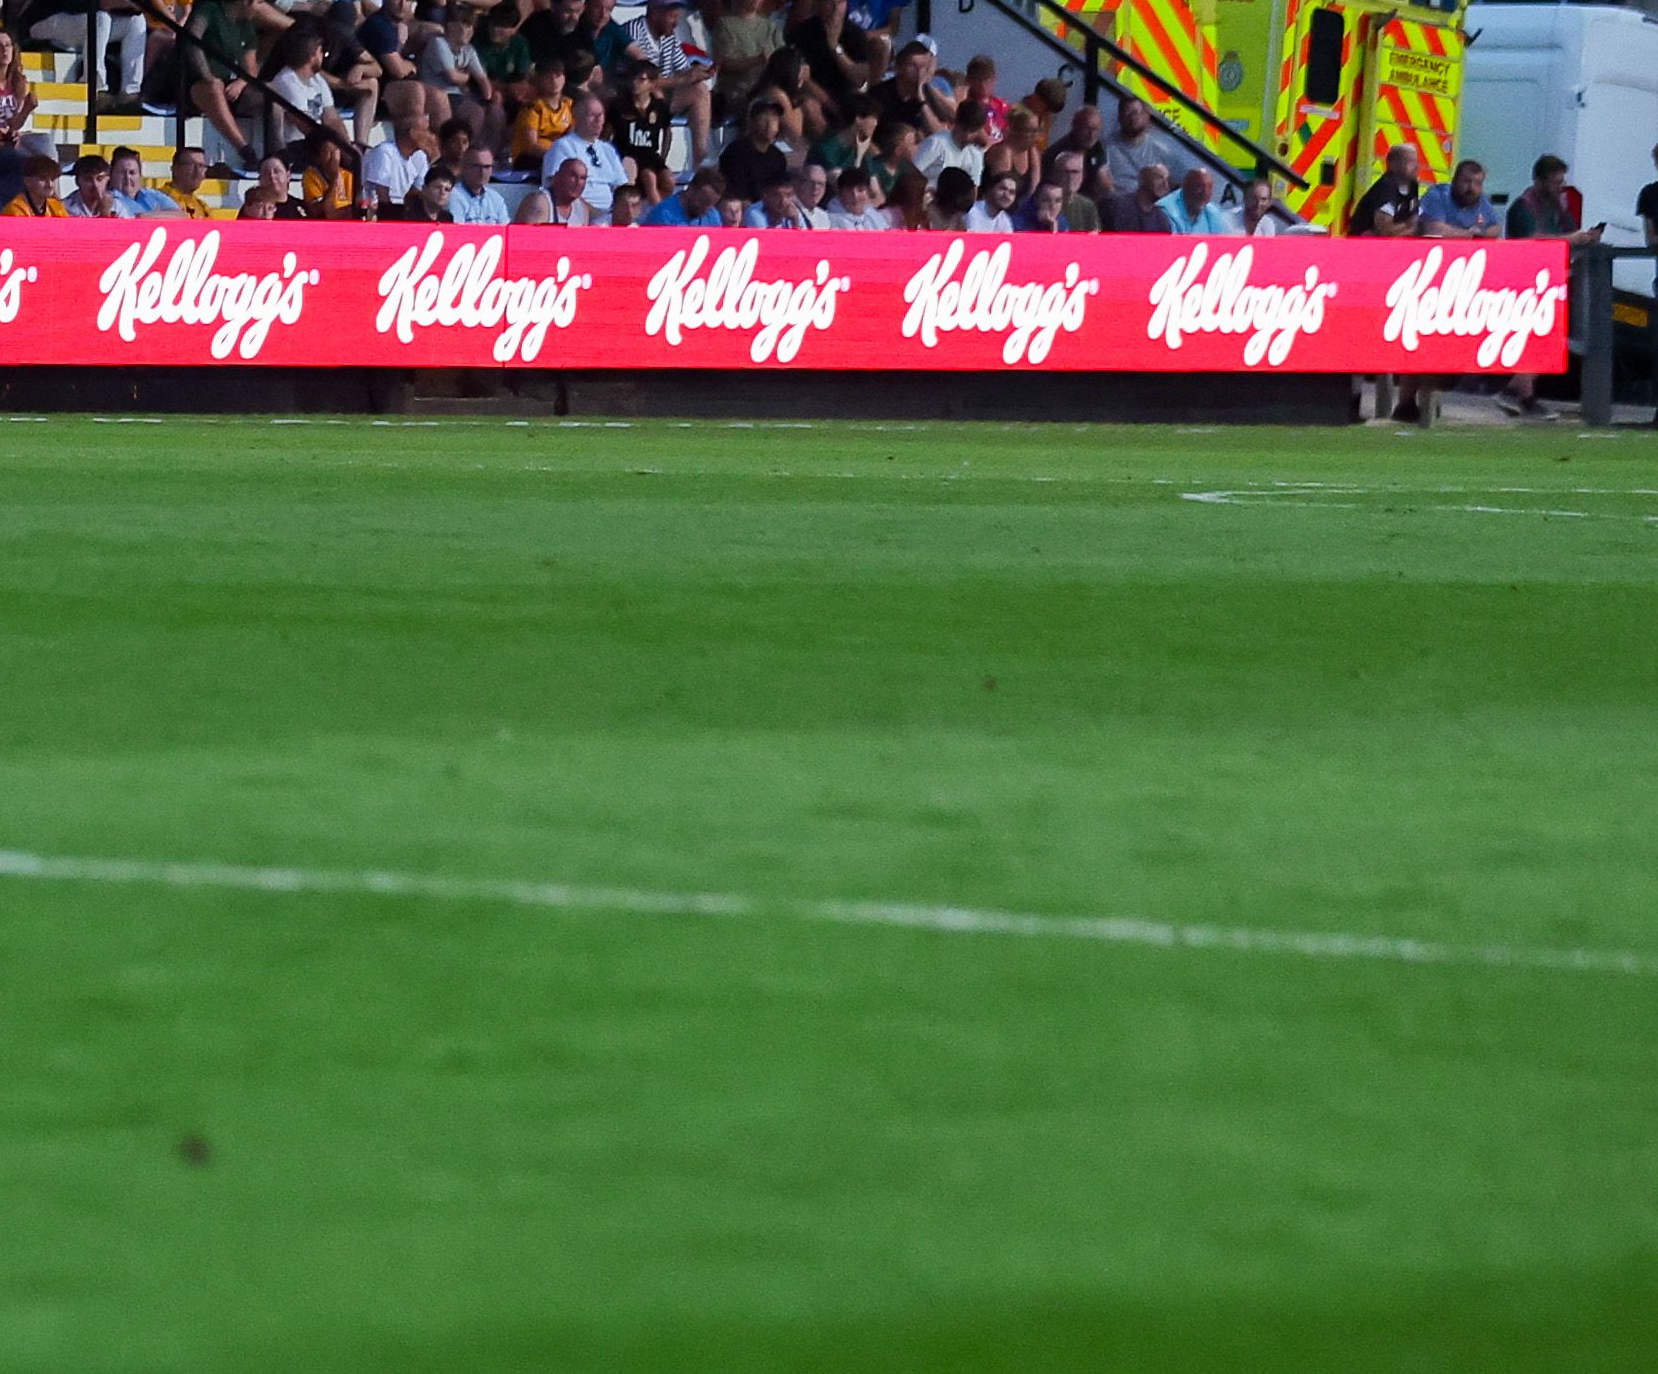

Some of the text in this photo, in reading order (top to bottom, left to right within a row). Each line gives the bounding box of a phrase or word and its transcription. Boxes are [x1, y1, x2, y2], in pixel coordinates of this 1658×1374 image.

[1220, 183, 1235, 205] A
[96, 226, 305, 359] Kellogg's
[375, 230, 579, 362] Kellogg's
[645, 234, 839, 363] Kellogg's
[901, 238, 1087, 365] Kellogg's
[1147, 241, 1326, 367] Kellogg's
[1383, 245, 1558, 368] Kellogg's
